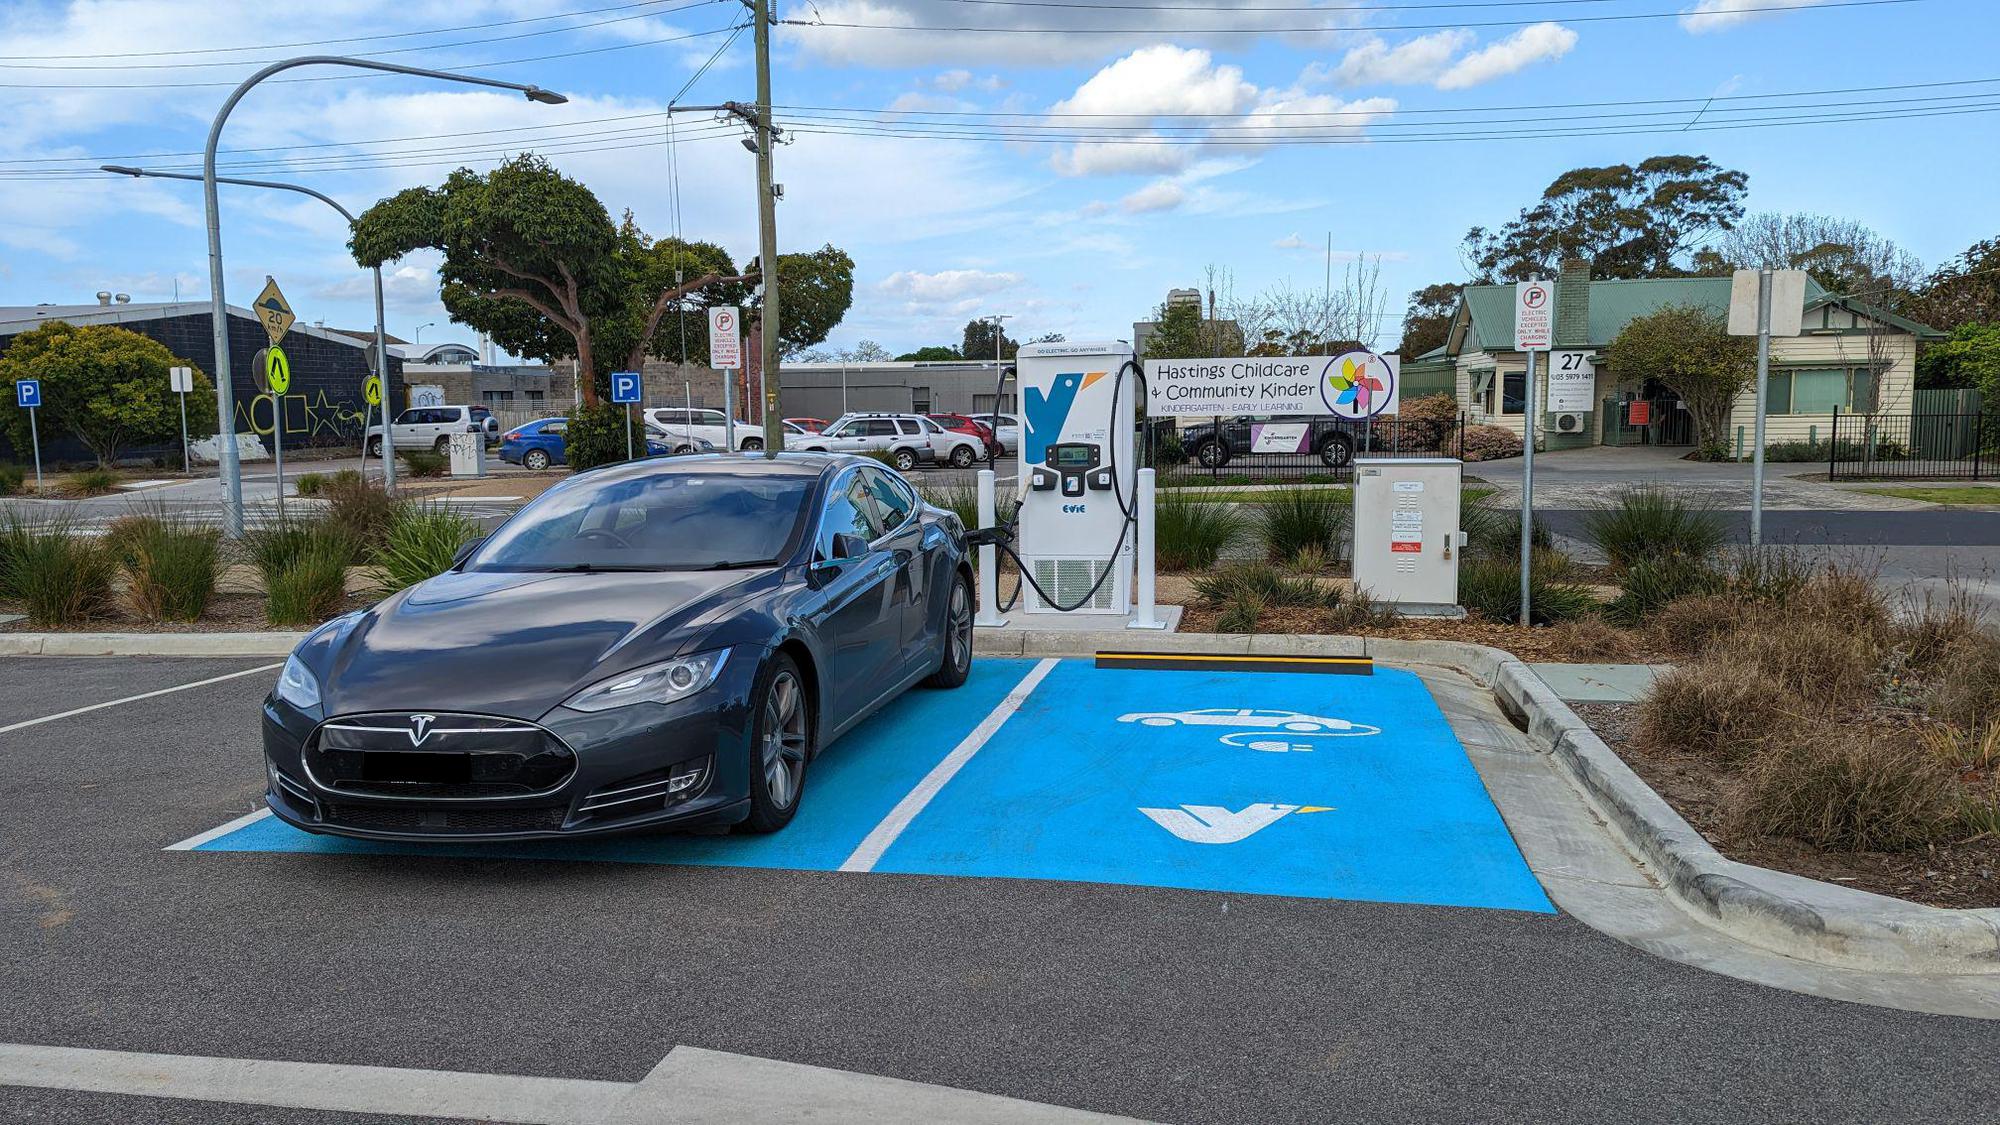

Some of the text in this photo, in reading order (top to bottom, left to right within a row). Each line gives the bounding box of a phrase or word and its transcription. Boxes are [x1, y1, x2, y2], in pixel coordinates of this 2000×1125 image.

[268, 311, 283, 325] 20
[267, 323, 284, 333] km/h
[1561, 353, 1584, 370] 27
[1158, 362, 1310, 380] Hastings Childcare
[22, 385, 35, 402] P
[618, 378, 634, 398] P
[1166, 383, 1255, 400] Community
[1260, 382, 1316, 399] Kinder
[1161, 403, 1225, 412] KINDERGARTEN
[1232, 403, 1258, 412] EARLY
[1260, 402, 1303, 411] LEARNING
